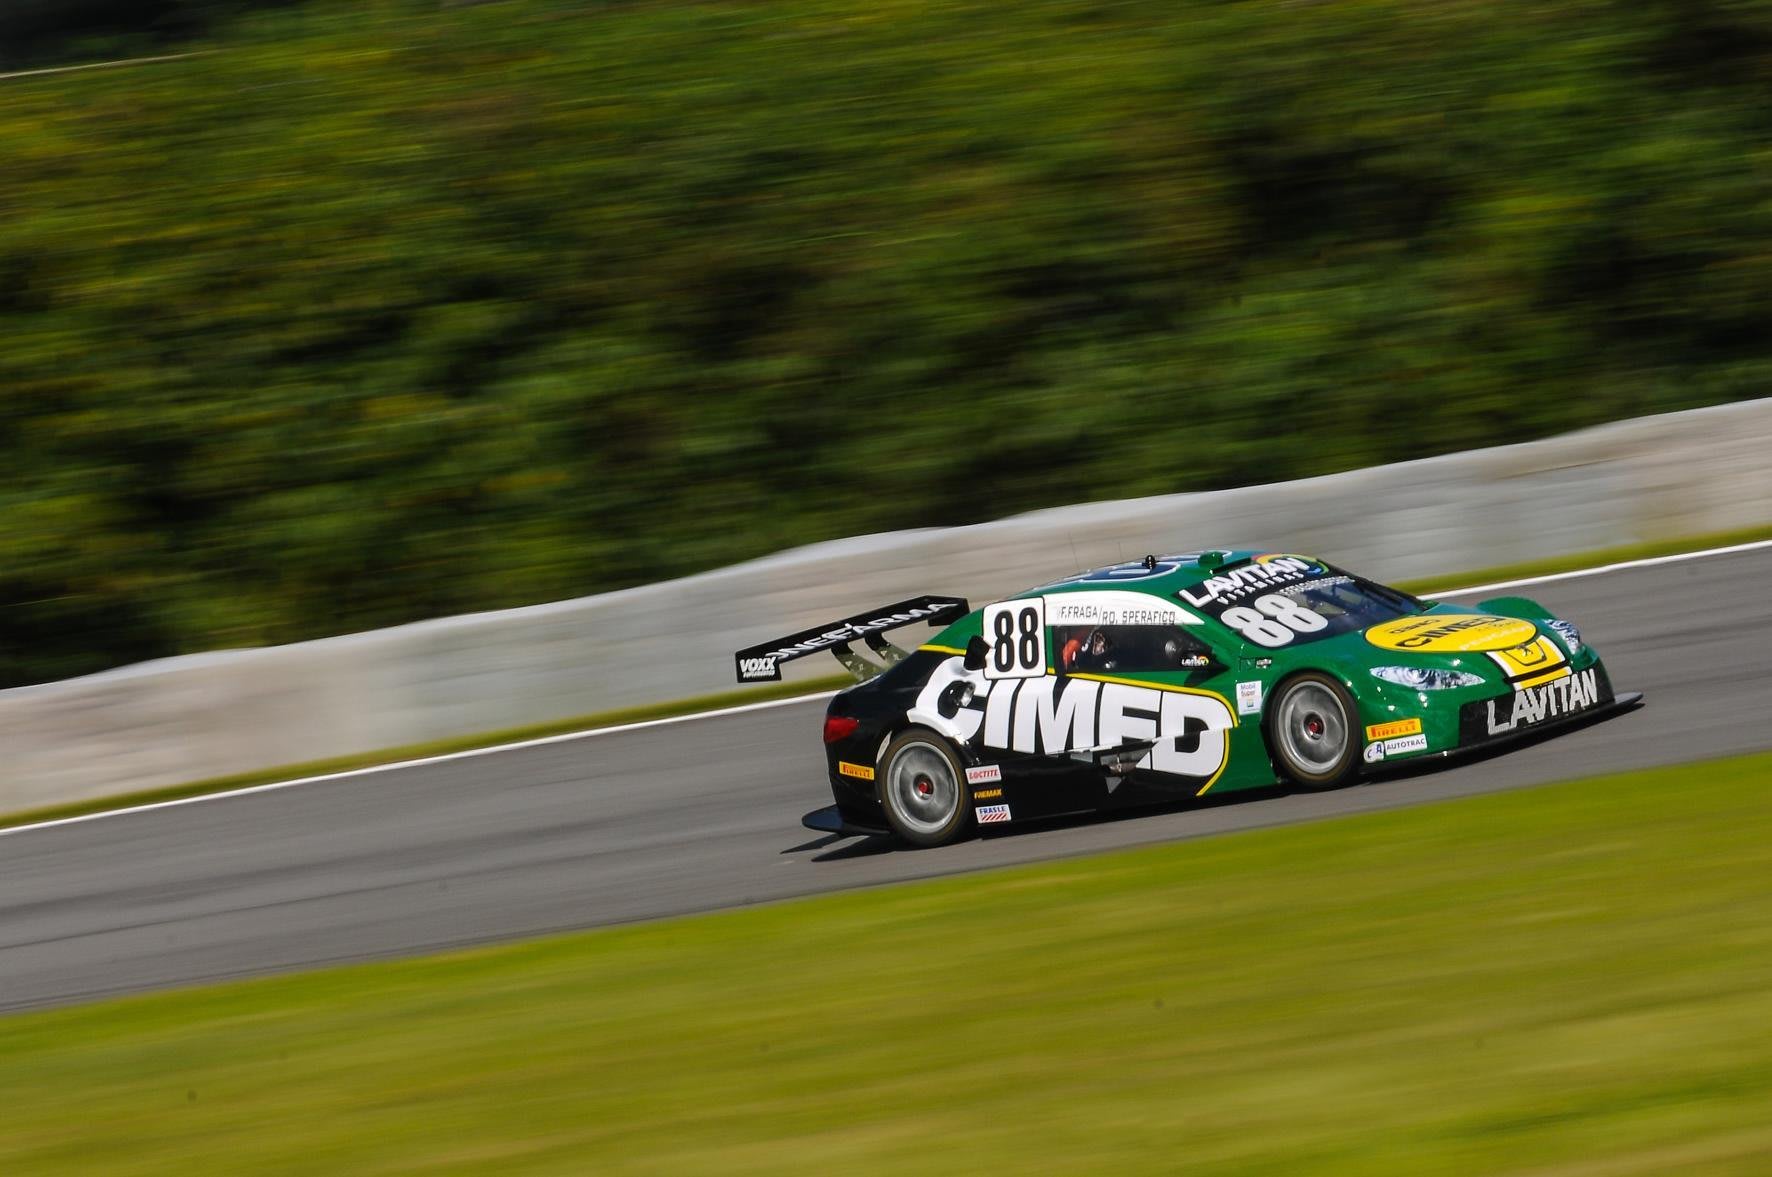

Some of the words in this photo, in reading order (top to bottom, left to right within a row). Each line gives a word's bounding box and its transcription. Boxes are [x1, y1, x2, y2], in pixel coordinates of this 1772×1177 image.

[1179, 557, 1310, 608] LAVITAN
[1217, 572, 1305, 605] VITAMINAS
[1122, 611, 1176, 625] SPERAFICO
[1220, 594, 1328, 647] 88
[1395, 617, 1506, 648] CIMED
[994, 607, 1040, 673] 88
[739, 656, 776, 673] VOXX
[907, 656, 1234, 776] CIMED
[1486, 668, 1599, 736] LAVITAN
[1371, 719, 1417, 738] PIRELLI
[1386, 738, 1425, 750] AUTOTRAC
[969, 768, 999, 780] LOCTITE
